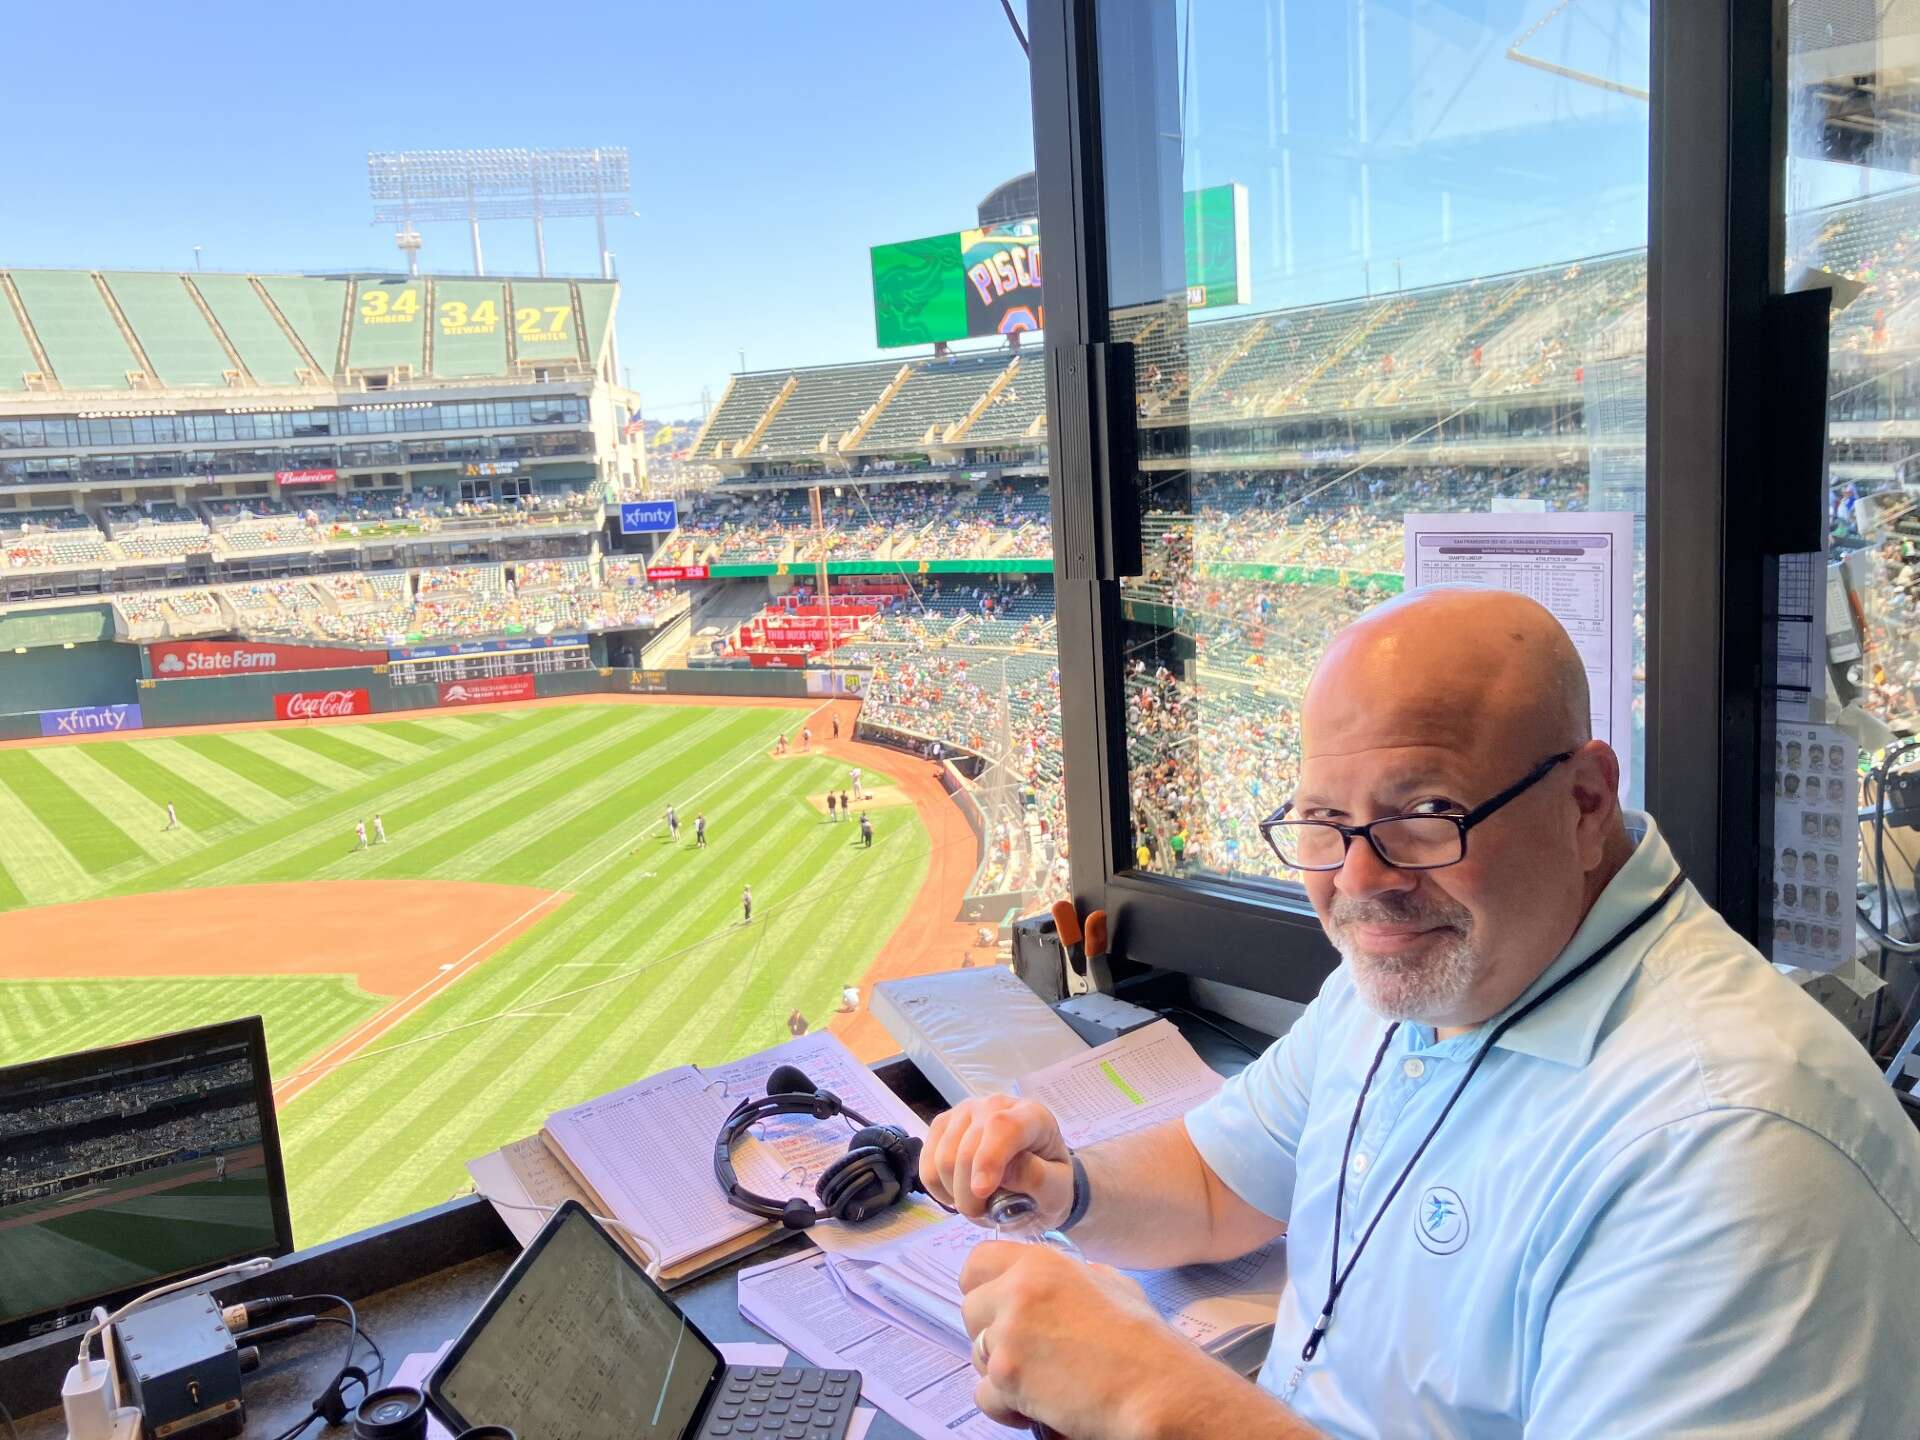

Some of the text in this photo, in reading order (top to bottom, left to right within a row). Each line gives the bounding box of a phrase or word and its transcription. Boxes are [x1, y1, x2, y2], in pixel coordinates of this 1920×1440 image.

[360, 288, 420, 317] 34
[440, 300, 500, 328] 34
[443, 325, 496, 336] STEWART
[515, 306, 571, 334] 27
[278, 470, 335, 484] Budweiser
[625, 508, 673, 527] xfinity
[287, 690, 357, 718] Coca-Cola
[57, 708, 126, 733] xfinity
